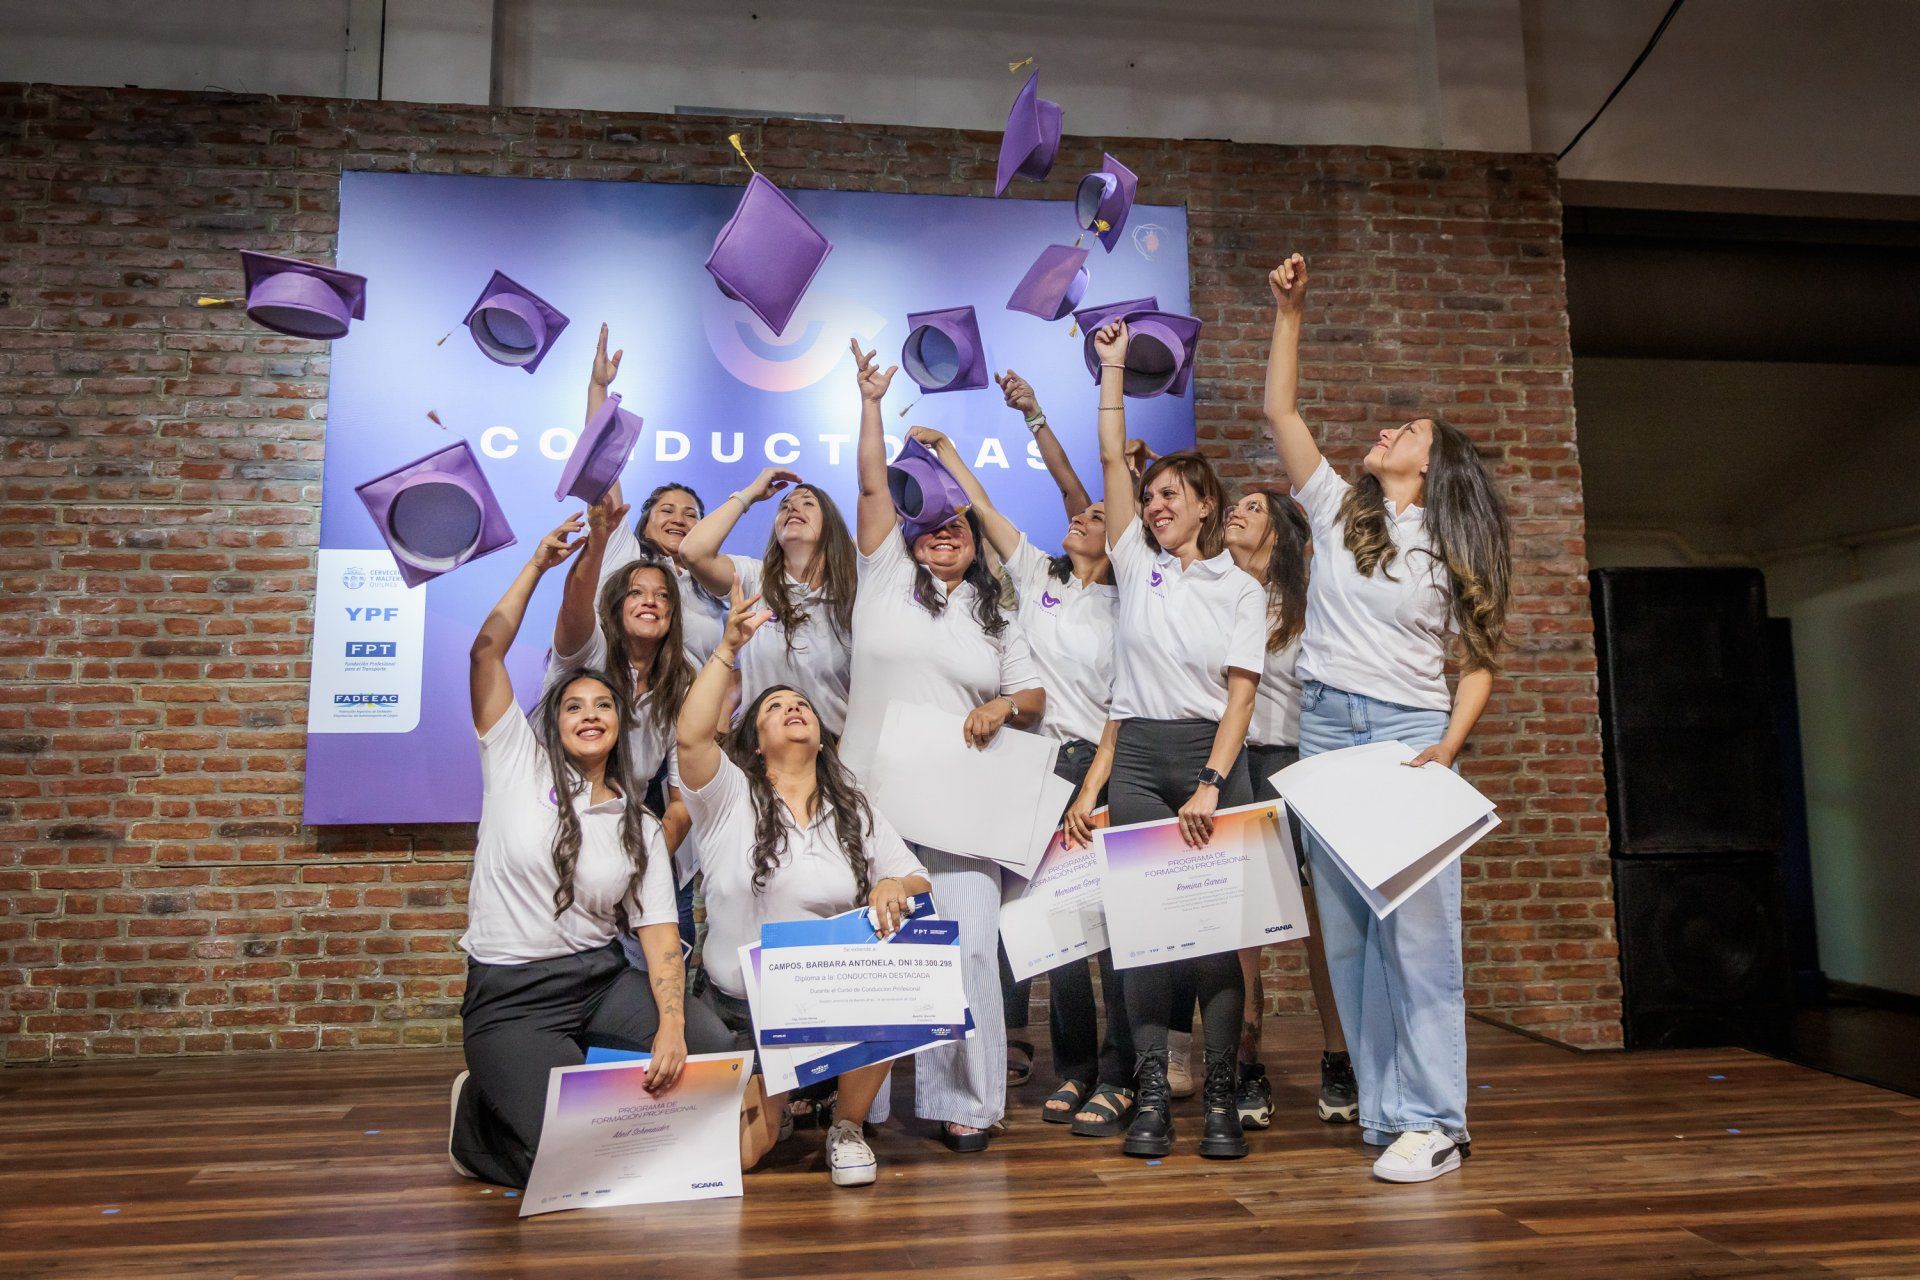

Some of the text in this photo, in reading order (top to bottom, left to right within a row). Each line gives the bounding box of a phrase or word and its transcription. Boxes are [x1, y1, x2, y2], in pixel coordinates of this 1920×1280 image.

[480, 426, 1050, 470] CODUCTAS
[345, 608, 399, 621] YPF
[351, 644, 391, 655] FPT
[1048, 854, 1090, 874] PROGRAMA
[1168, 851, 1226, 867] PROGRAMA DE
[1195, 855, 1251, 870] PROFESIONAL
[1074, 859, 1098, 873] PROFE
[1176, 882, 1202, 892] Romina
[1265, 923, 1293, 934] SCANIA
[769, 962, 804, 971] CAMPOS,
[806, 960, 847, 969] BARBARA
[849, 959, 897, 967] ANTONELA,
[898, 959, 912, 967] DNI
[836, 972, 887, 980] CONDUCTORA
[618, 1100, 678, 1114] PROGRAMA DE
[643, 1104, 697, 1118] PROFESIONAL
[691, 1181, 724, 1189] SCANIA
